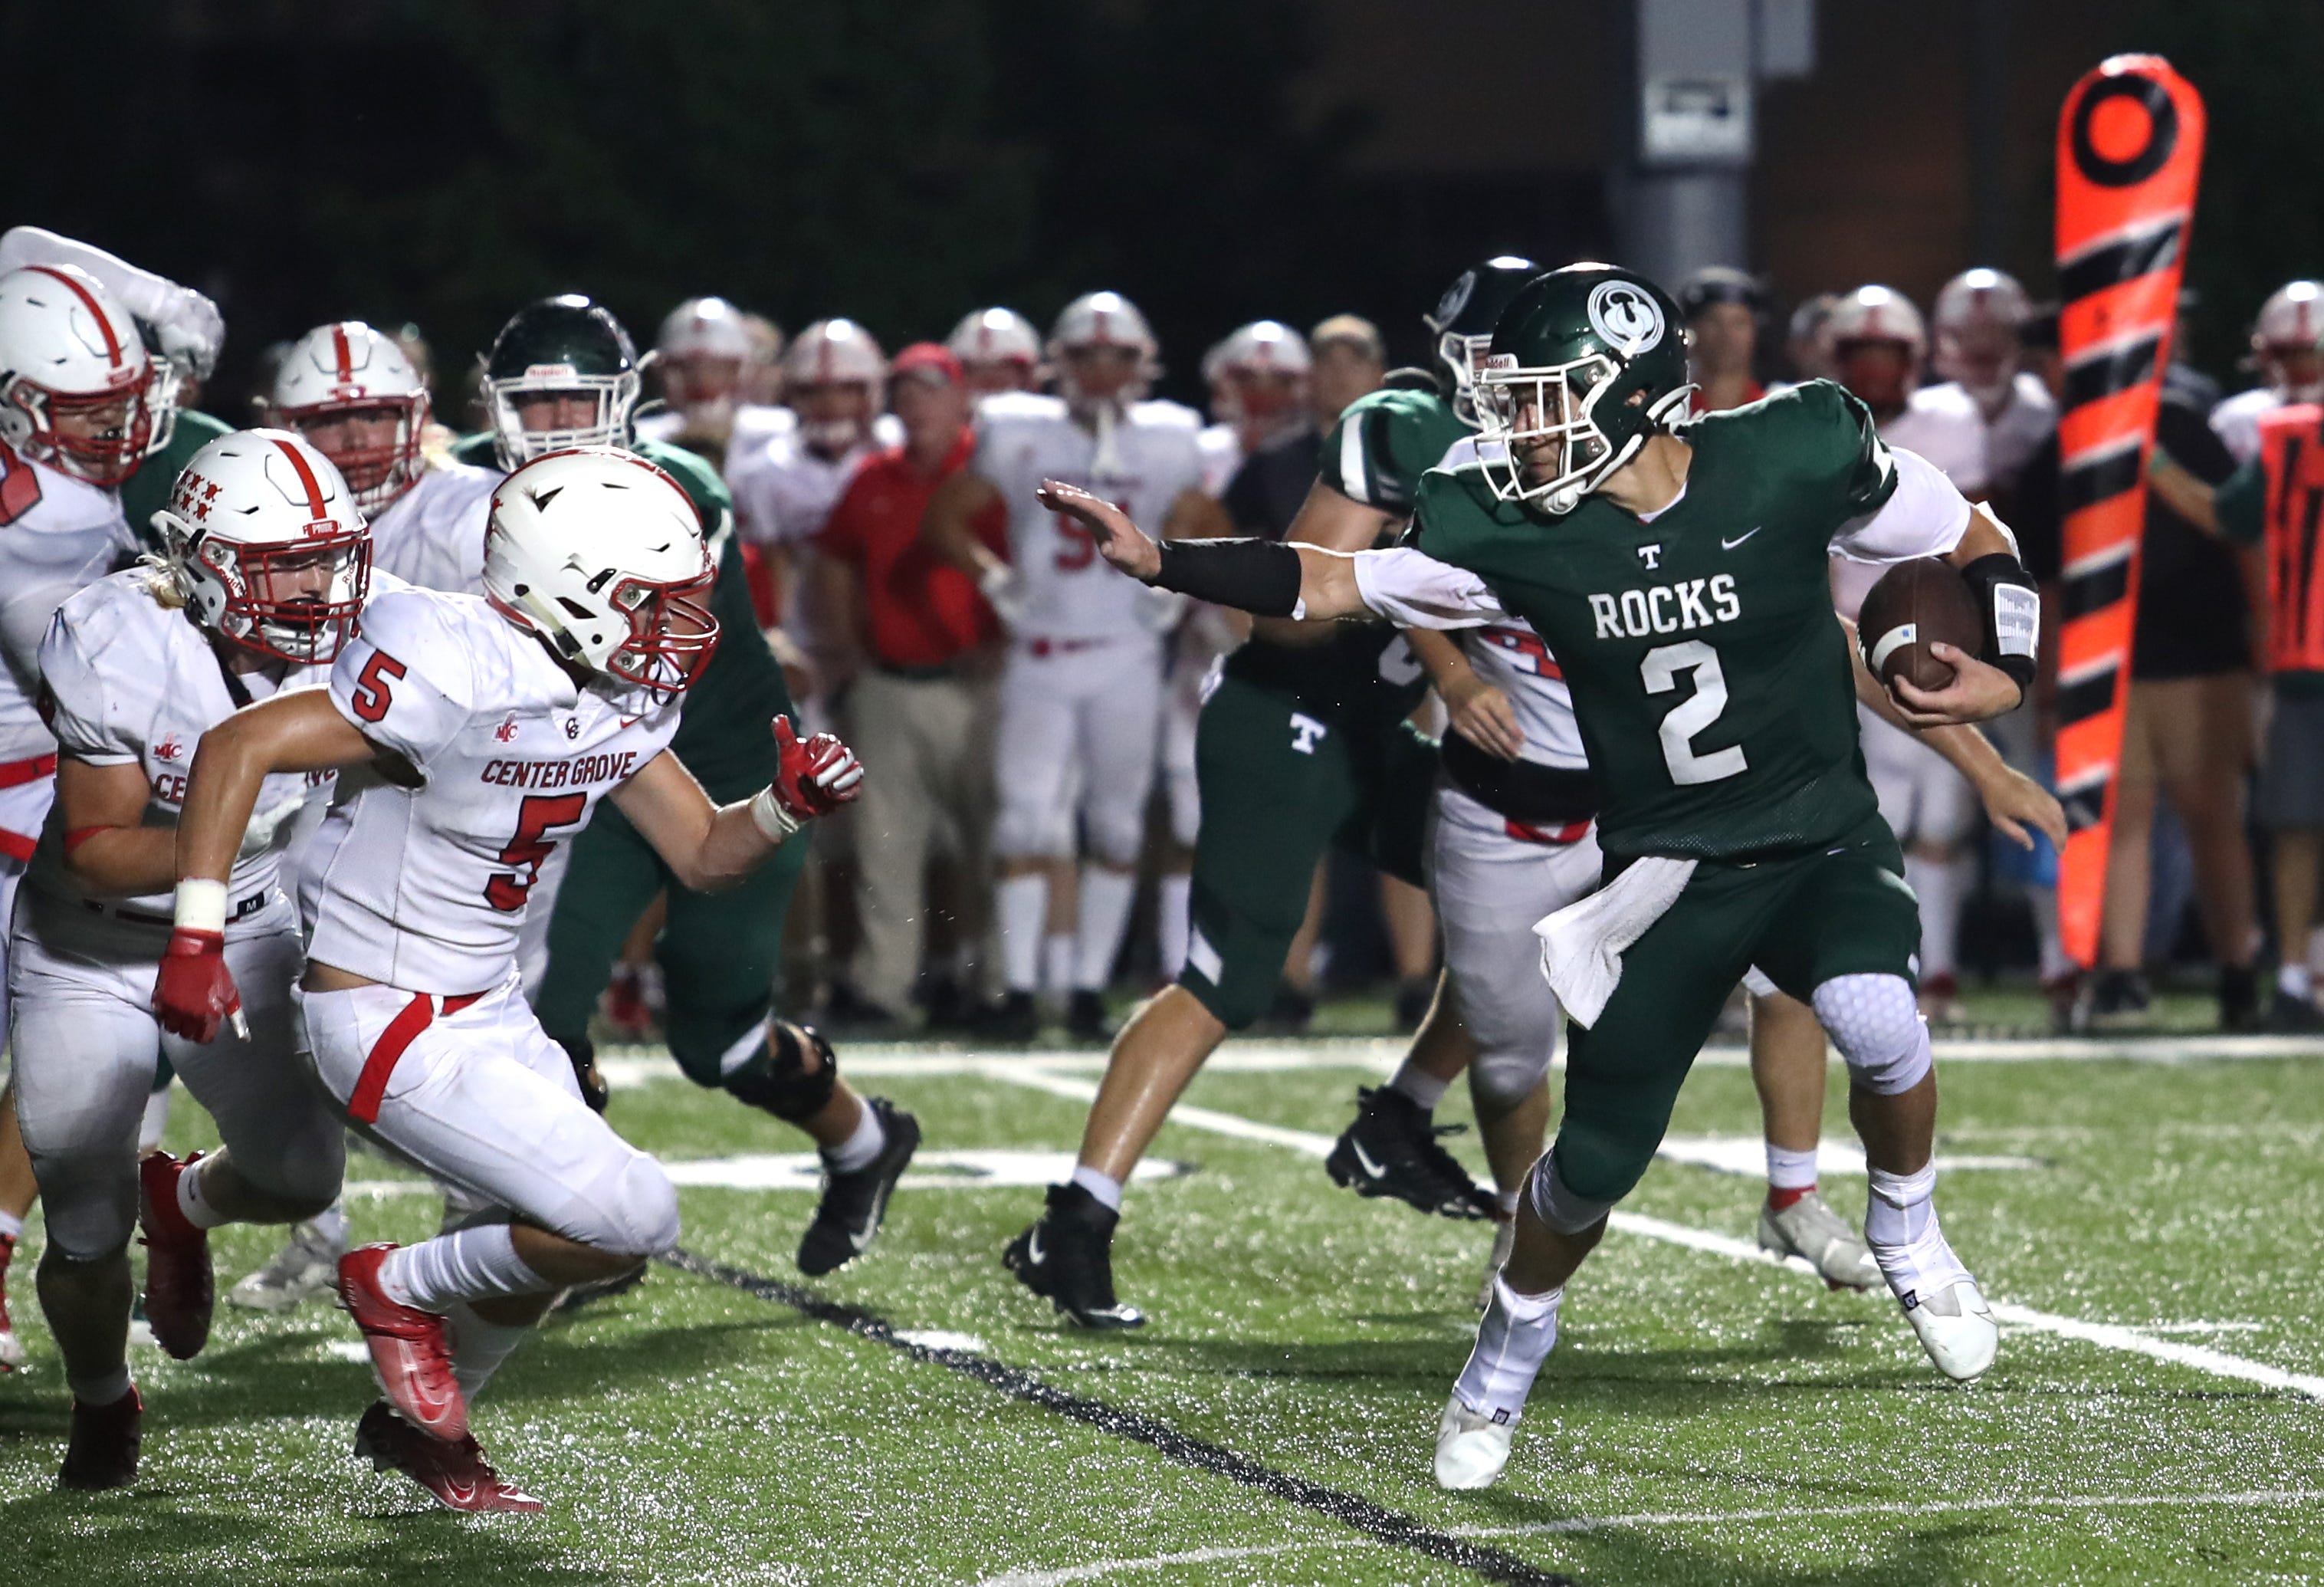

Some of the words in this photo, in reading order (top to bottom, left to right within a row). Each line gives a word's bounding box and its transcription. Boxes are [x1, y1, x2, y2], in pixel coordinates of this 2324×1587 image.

[1637, 544, 1662, 570] T
[1587, 573, 1741, 639] ROCKS
[351, 648, 408, 723] 5
[1640, 639, 1748, 786] 2
[1289, 711, 1328, 755] T
[481, 759, 570, 788] CENTER
[570, 751, 638, 785] GROVE
[482, 790, 588, 912] 5
[246, 899, 257, 912] M
